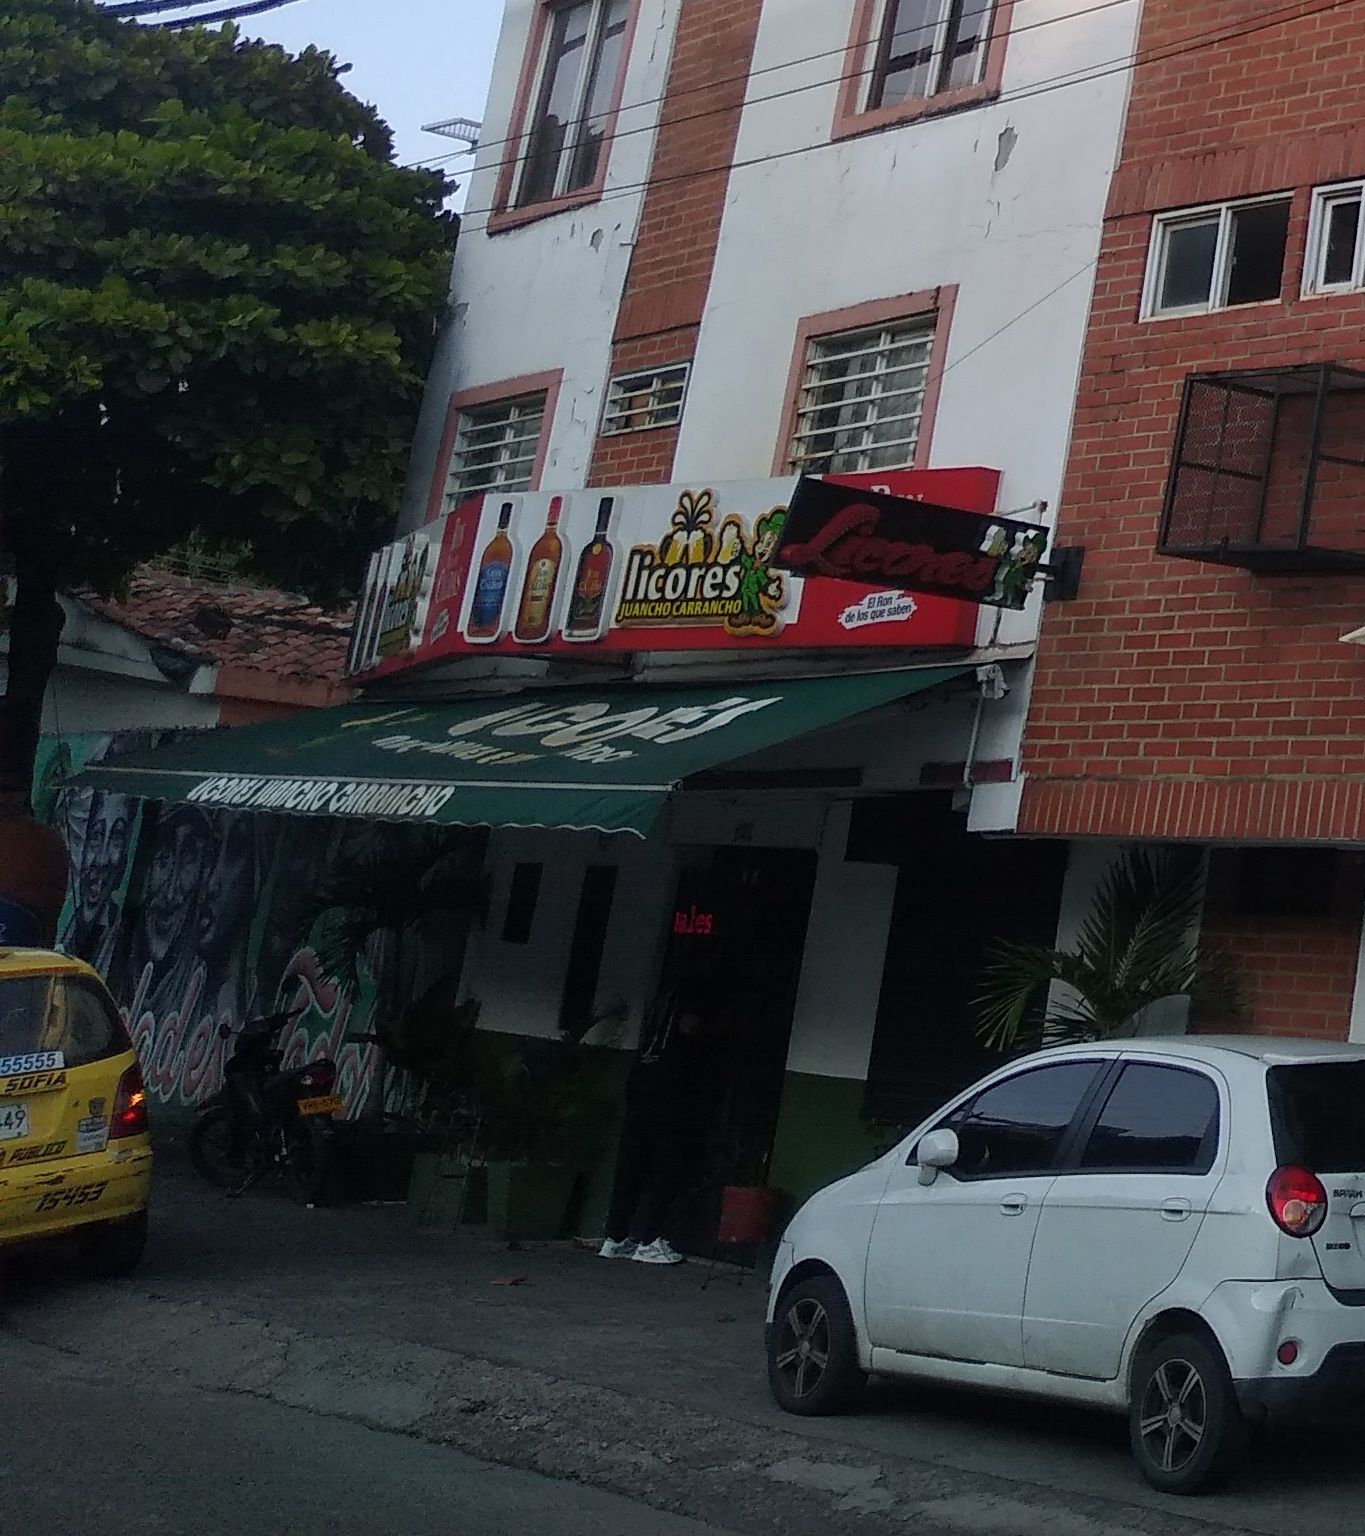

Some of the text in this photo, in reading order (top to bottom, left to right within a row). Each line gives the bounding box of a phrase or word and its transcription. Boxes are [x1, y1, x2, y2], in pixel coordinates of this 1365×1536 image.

[624, 553, 742, 600] licores
[618, 599, 742, 620] JUANCHO CARRANCHO
[867, 596, 893, 609] El Ron
[845, 604, 912, 623] de los que saben
[246, 779, 338, 811] JUANCHO
[328, 782, 455, 815] CARRANCHO
